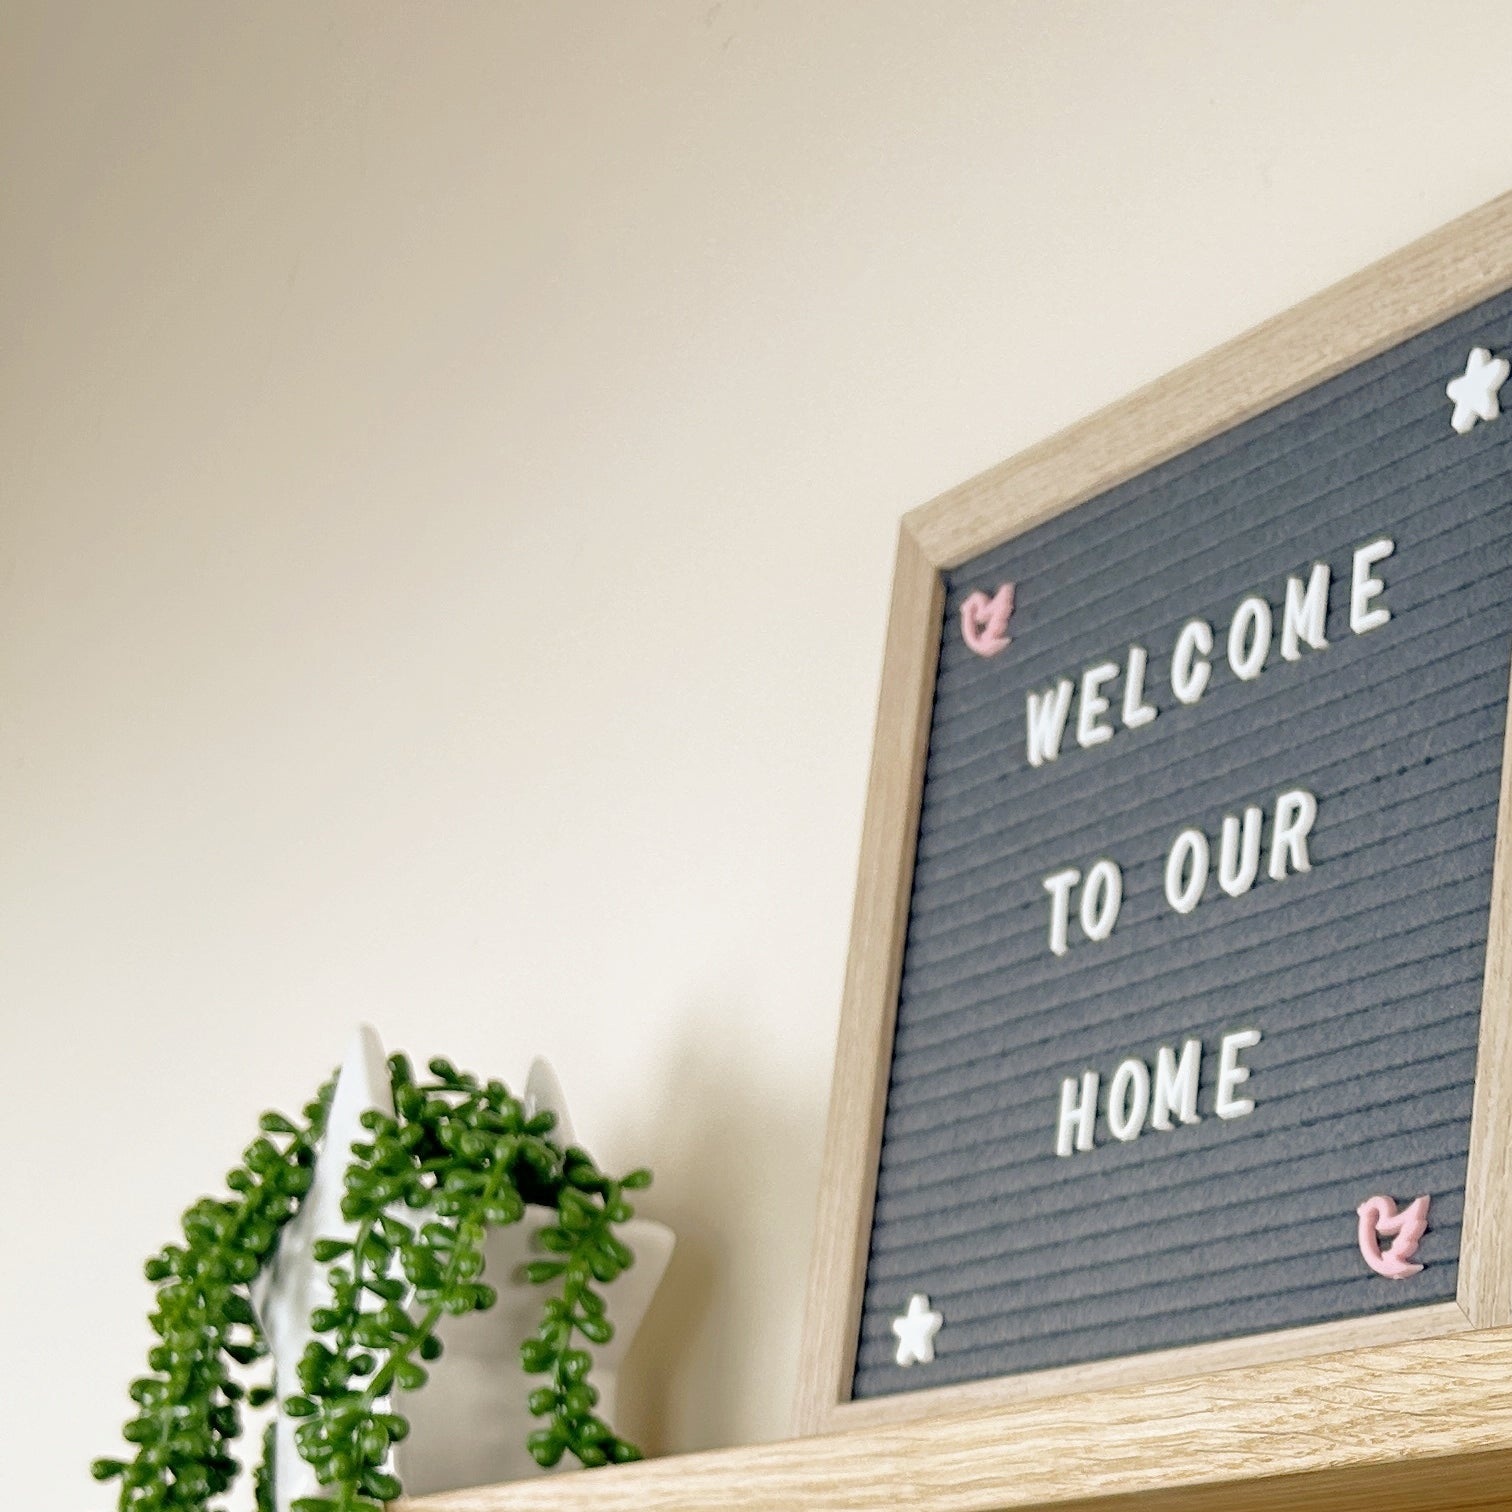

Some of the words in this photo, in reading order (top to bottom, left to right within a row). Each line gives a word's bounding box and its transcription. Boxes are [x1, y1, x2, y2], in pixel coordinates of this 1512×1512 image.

[1026, 539, 1395, 767] WELCOME
[1042, 860, 1122, 956] TO
[1164, 790, 1317, 913] OUR
[1056, 1030, 1262, 1156] HOME
